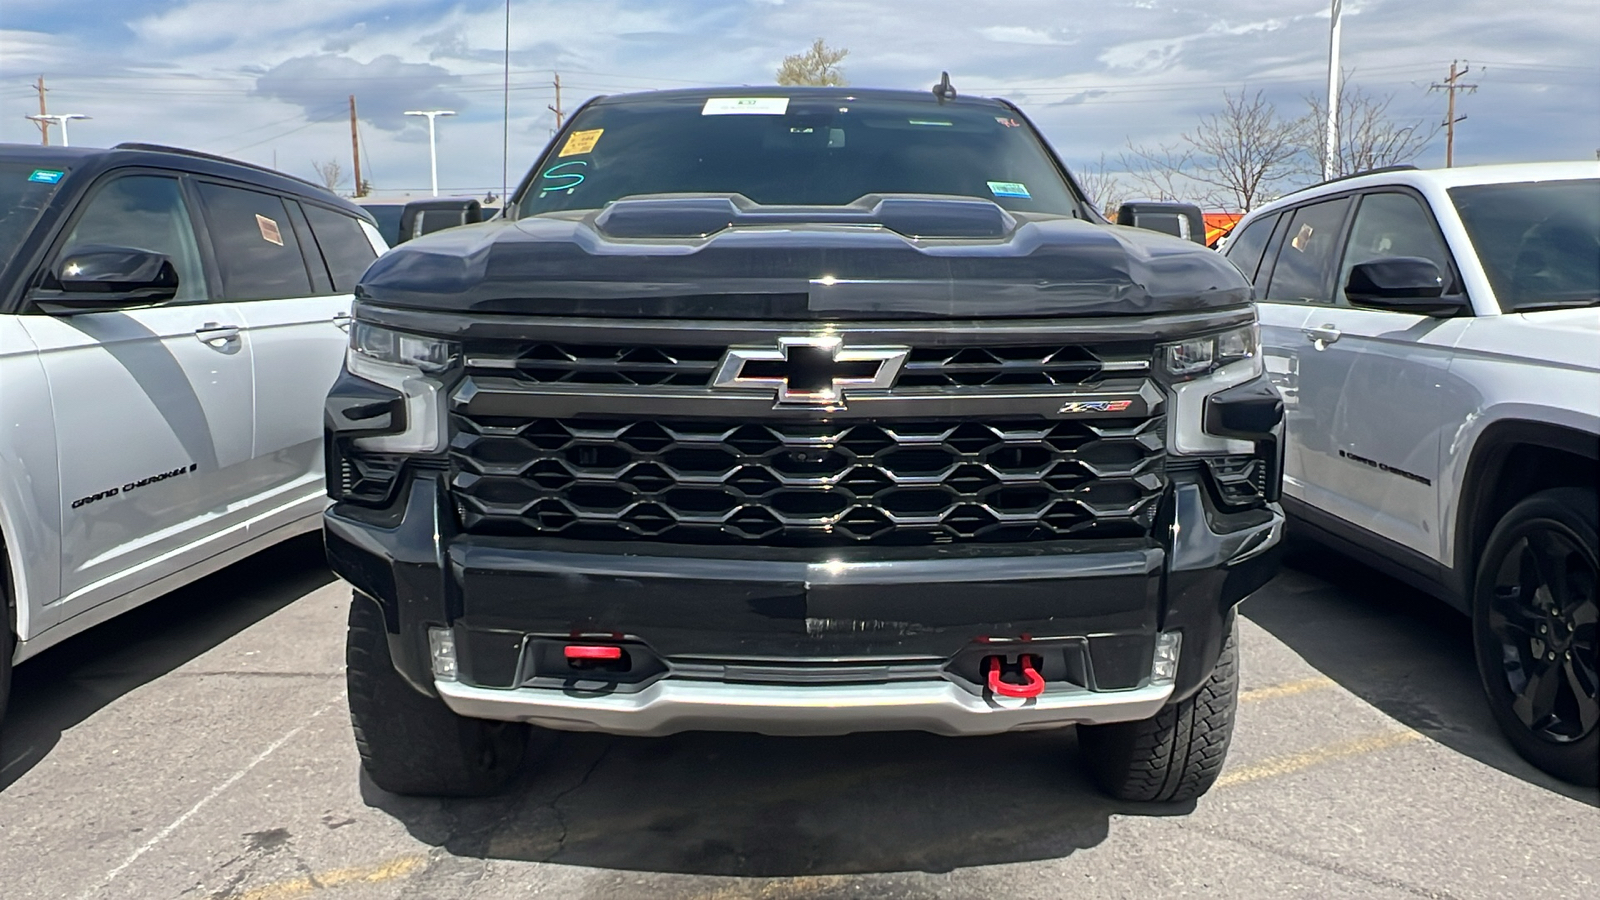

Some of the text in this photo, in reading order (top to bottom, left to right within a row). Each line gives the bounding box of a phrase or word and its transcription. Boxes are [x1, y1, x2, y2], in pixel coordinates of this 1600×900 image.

[542, 161, 587, 191] S
[1057, 400, 1133, 414] ZR2
[71, 487, 118, 509] GRAND
[122, 466, 188, 492] CHEROKEE
